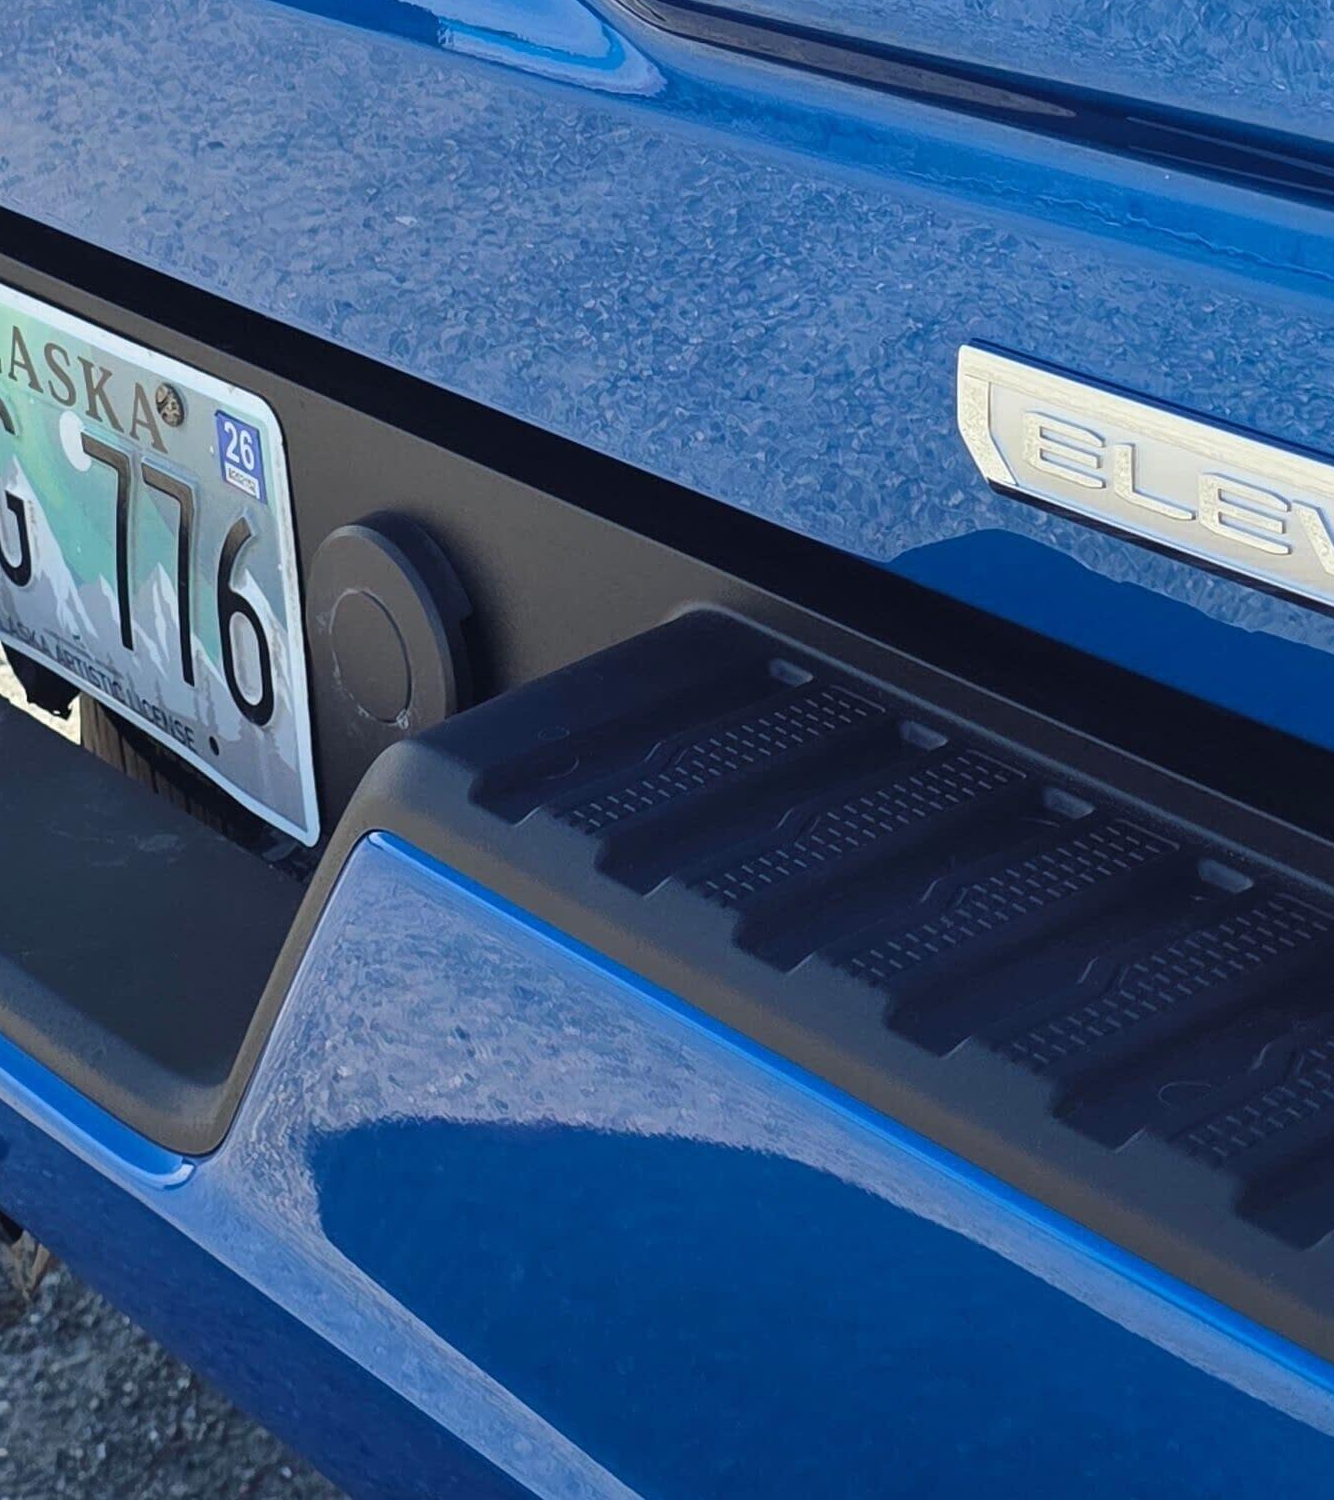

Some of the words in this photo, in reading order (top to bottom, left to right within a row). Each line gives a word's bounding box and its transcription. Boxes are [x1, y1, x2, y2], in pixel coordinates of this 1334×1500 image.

[224, 421, 255, 471] 26
[81, 430, 275, 728] 776
[126, 687, 195, 748] LICENSE
